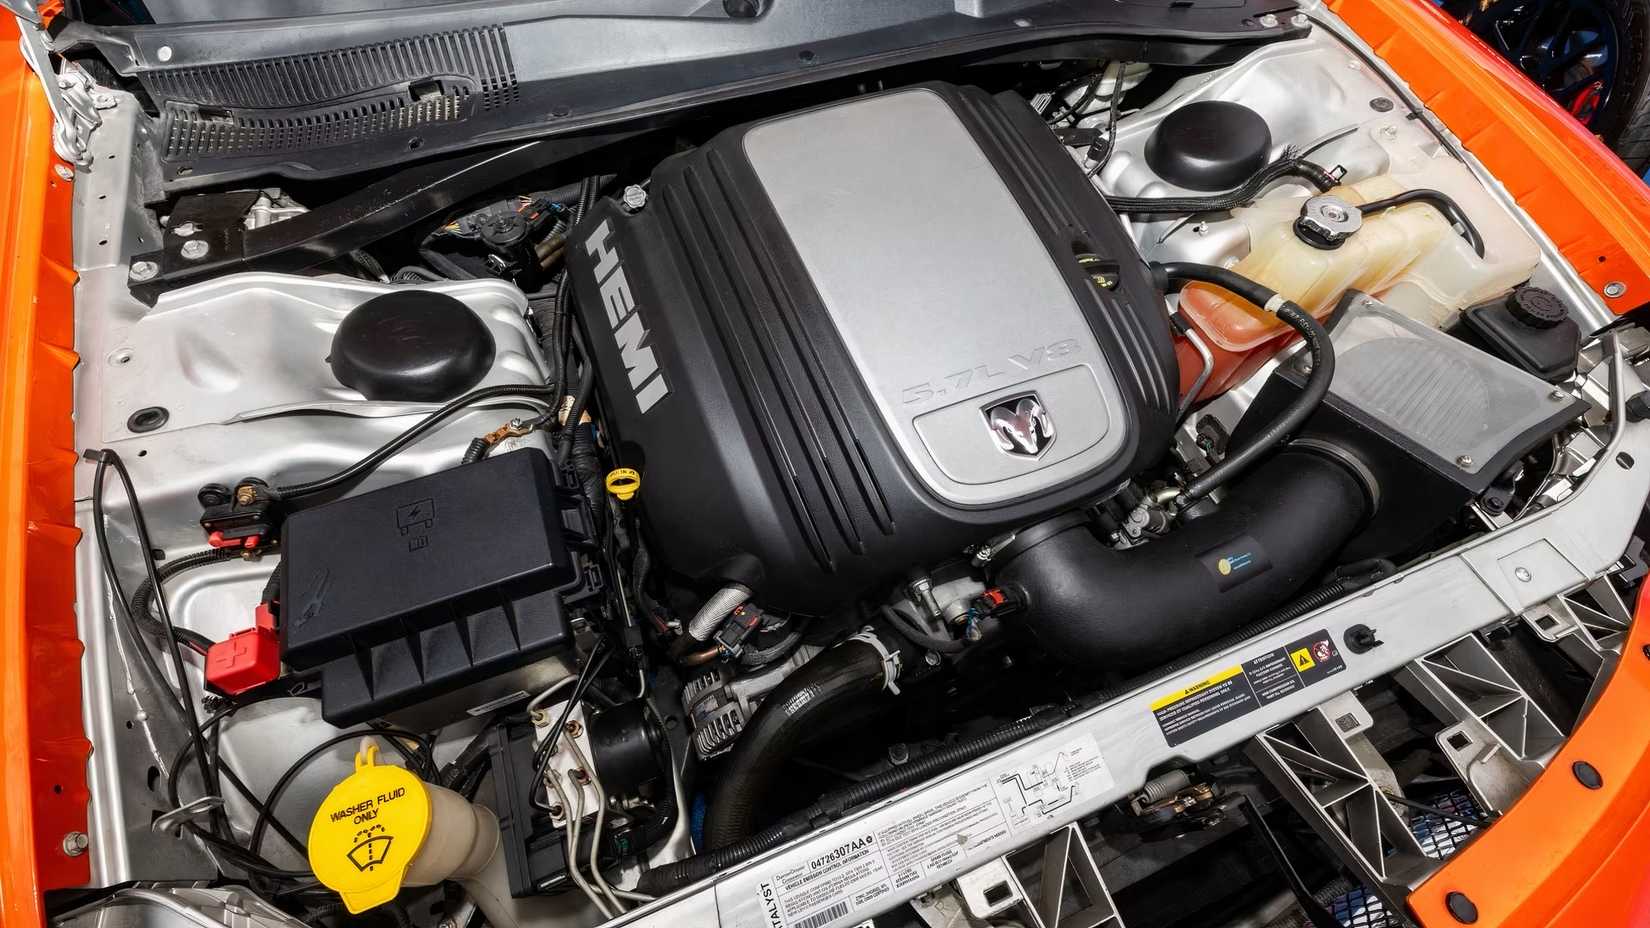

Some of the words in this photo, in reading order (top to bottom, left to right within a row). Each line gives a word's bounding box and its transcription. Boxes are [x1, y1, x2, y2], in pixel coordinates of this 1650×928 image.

[585, 219, 669, 414] HEMI
[902, 364, 1005, 404] 5.7L
[1008, 338, 1082, 370] V8
[330, 799, 373, 822] WASHER
[377, 787, 406, 805] FLUID
[353, 807, 379, 825] ONLY
[811, 837, 866, 870] 04726307AA
[760, 883, 783, 928] TALYST
